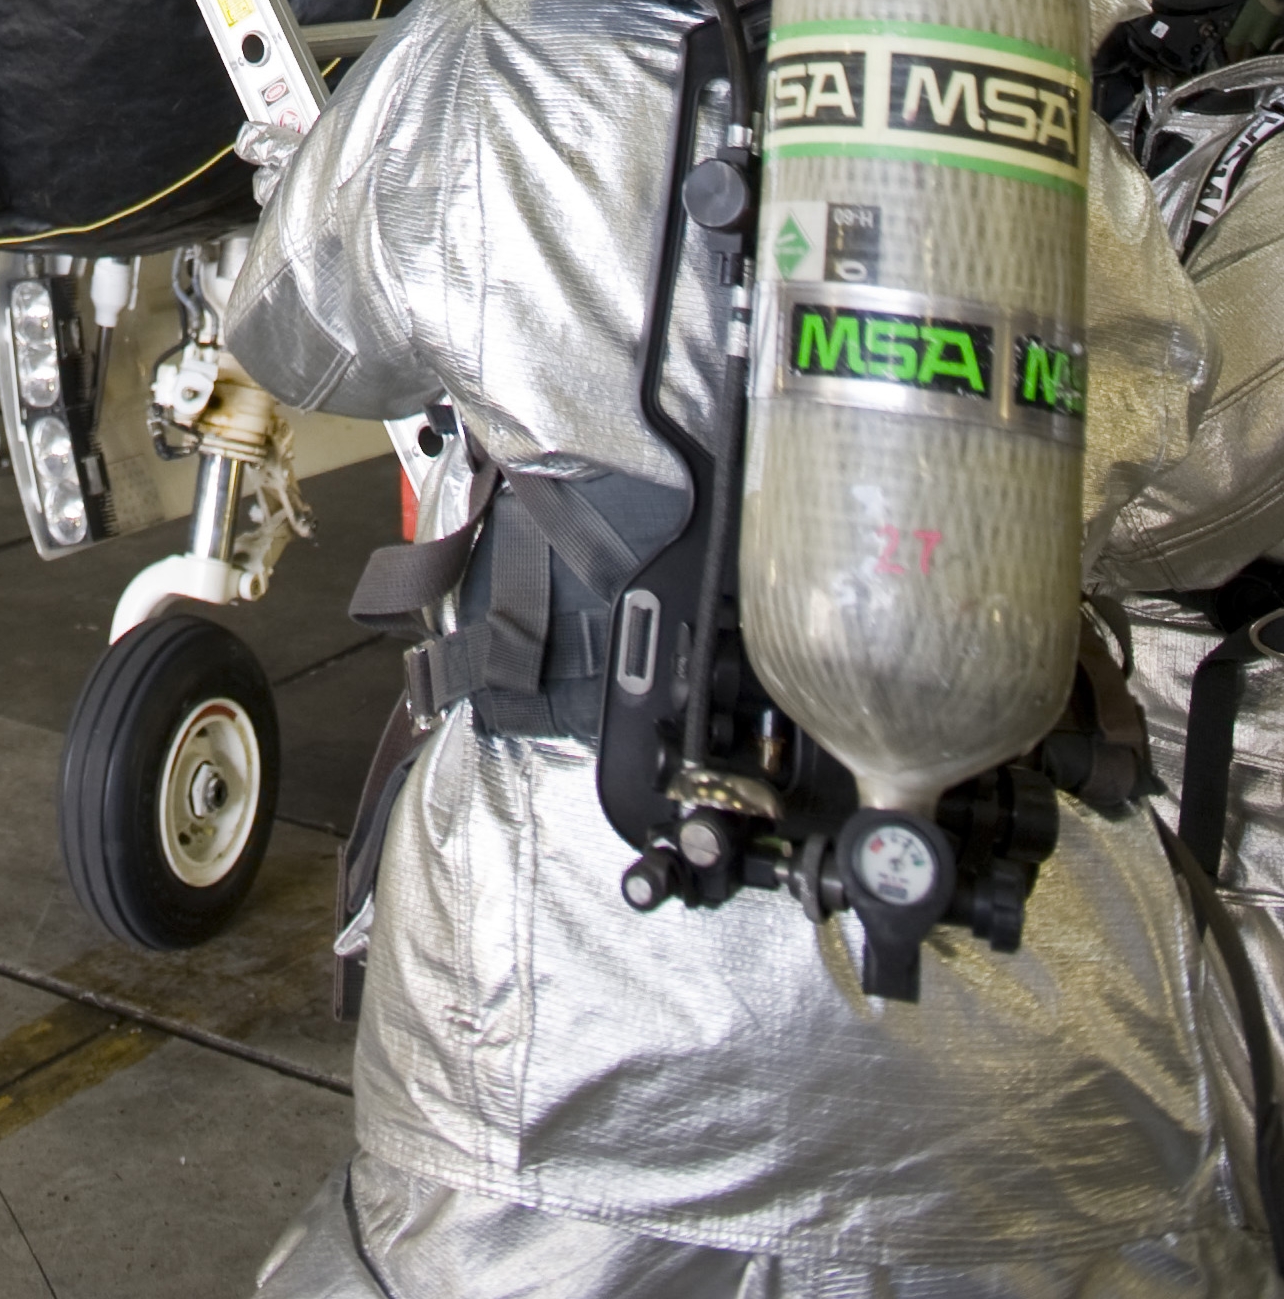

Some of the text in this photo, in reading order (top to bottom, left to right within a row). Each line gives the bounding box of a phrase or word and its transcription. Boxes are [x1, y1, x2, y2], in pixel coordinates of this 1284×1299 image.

[901, 64, 1077, 155] MSA
[797, 313, 986, 392] MSA
[873, 522, 943, 576] 27
